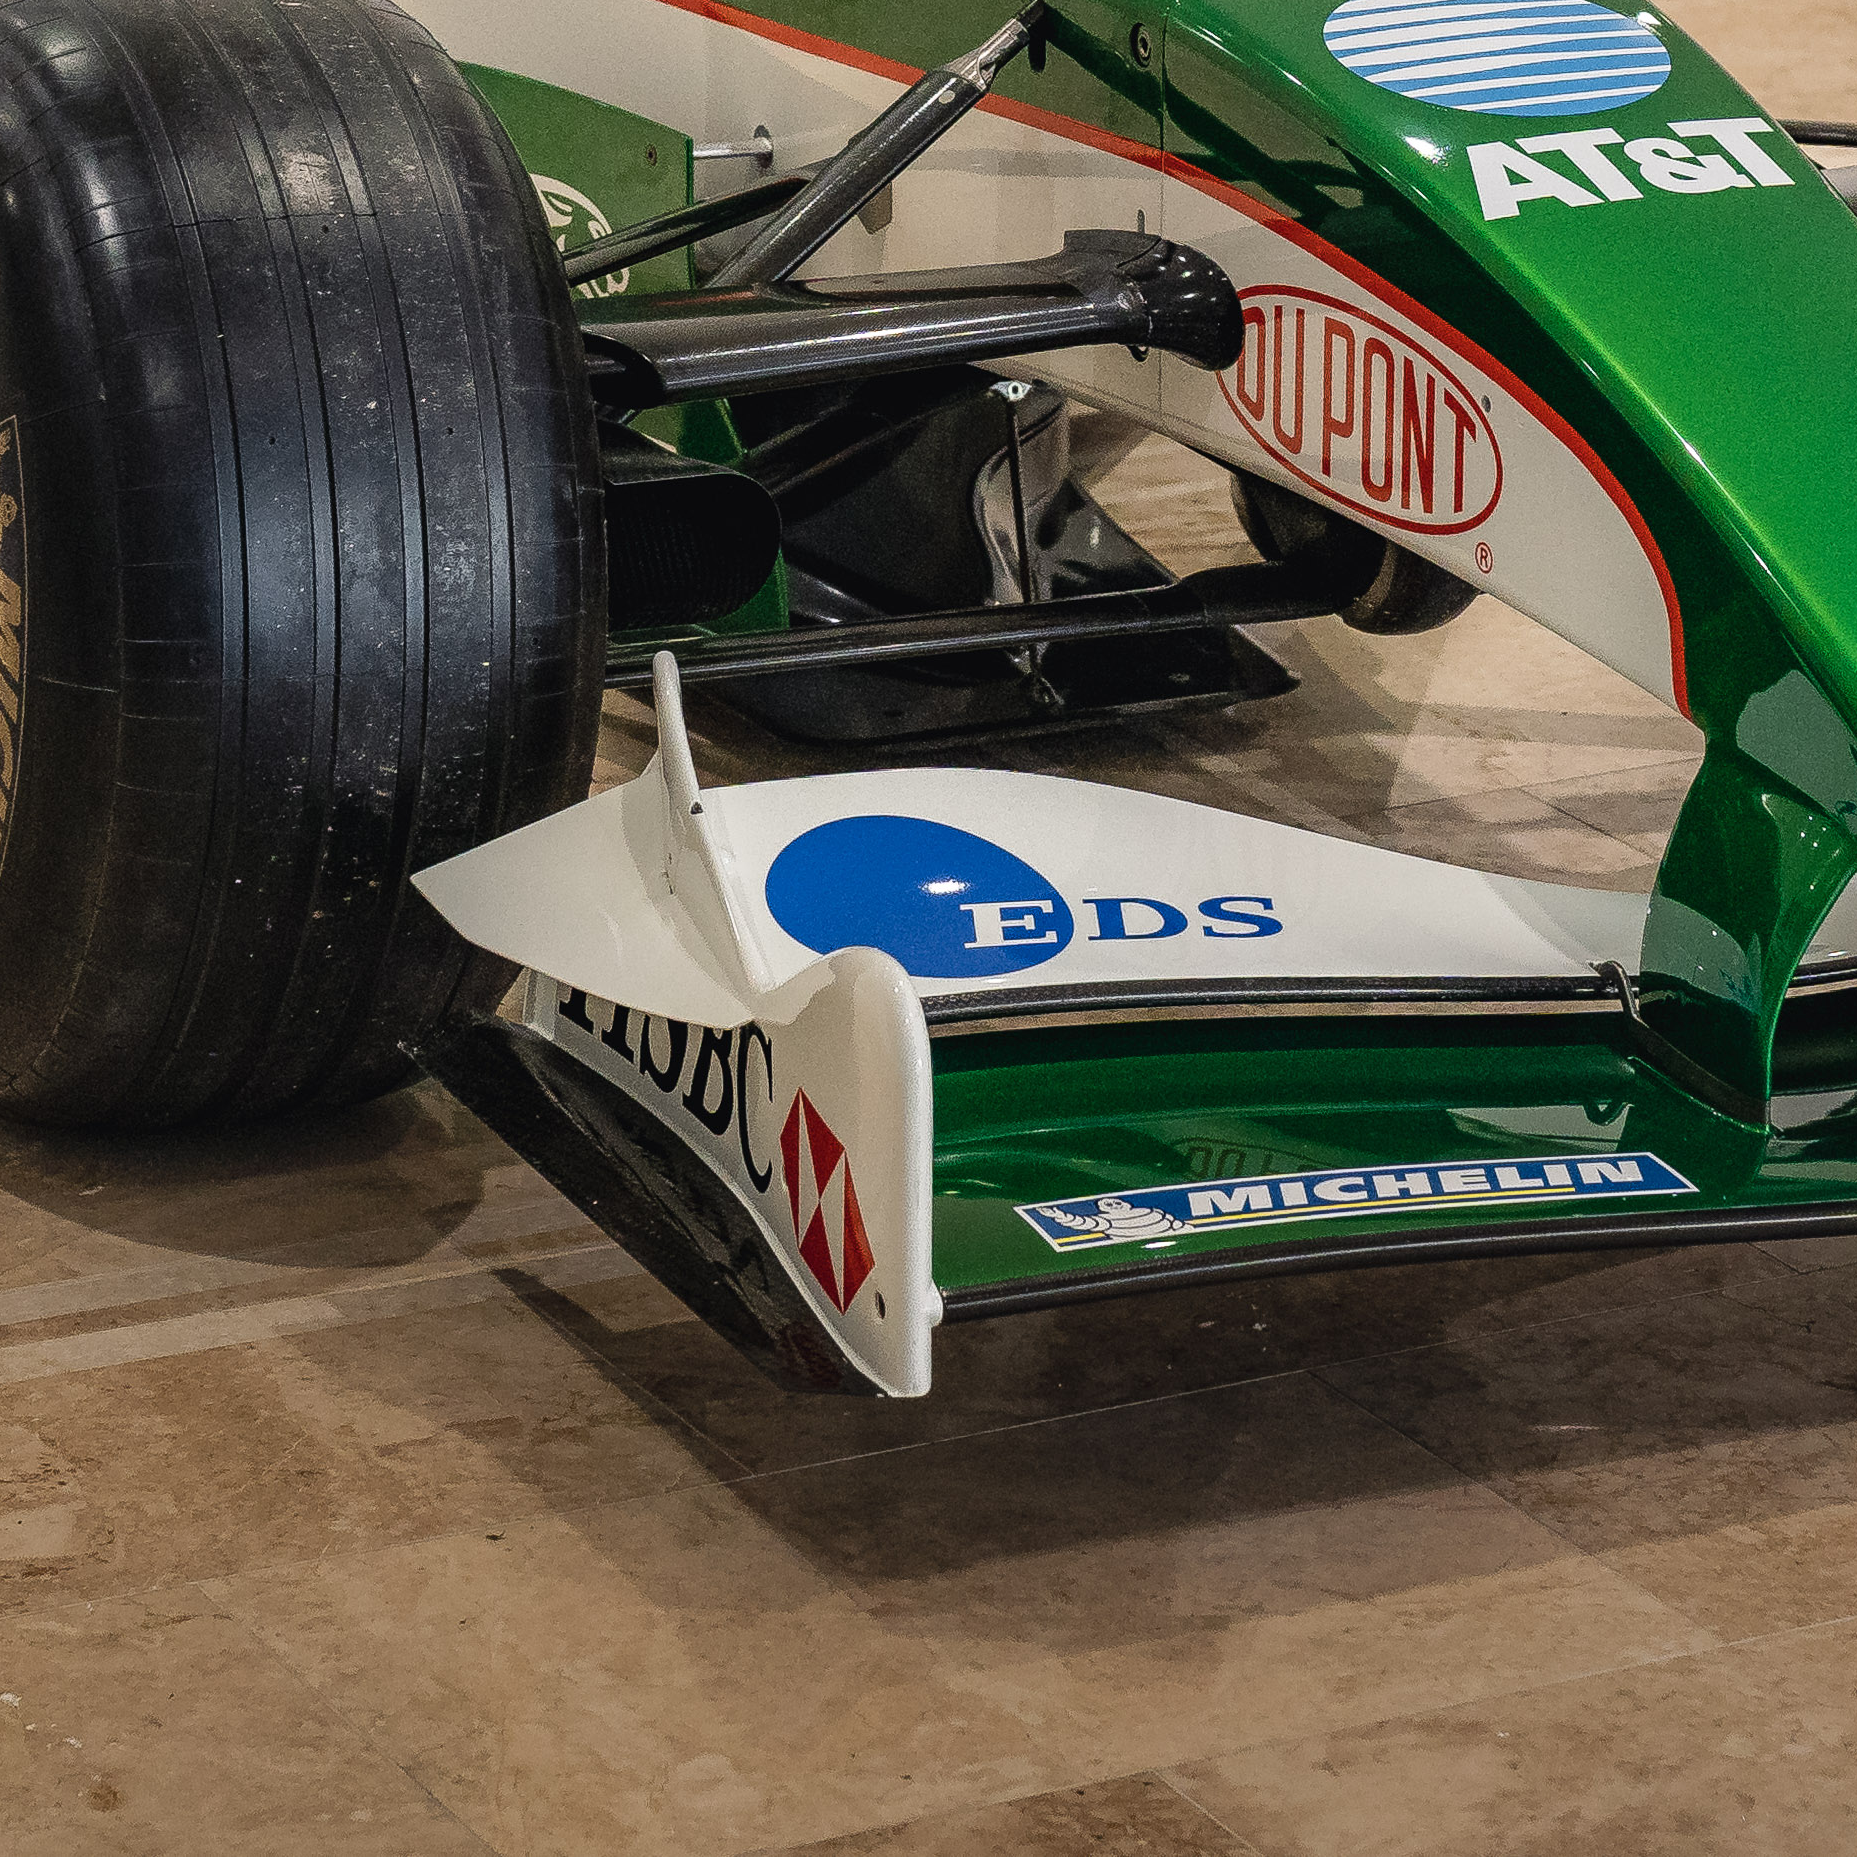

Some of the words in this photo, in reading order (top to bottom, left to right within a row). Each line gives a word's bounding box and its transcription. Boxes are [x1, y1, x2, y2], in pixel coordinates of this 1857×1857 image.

[1465, 117, 1796, 222] AT&T
[1236, 304, 1306, 456] DU
[1321, 315, 1478, 515] PONT
[959, 896, 1284, 949] EDS
[1187, 1157, 1645, 1218] MICHELIN
